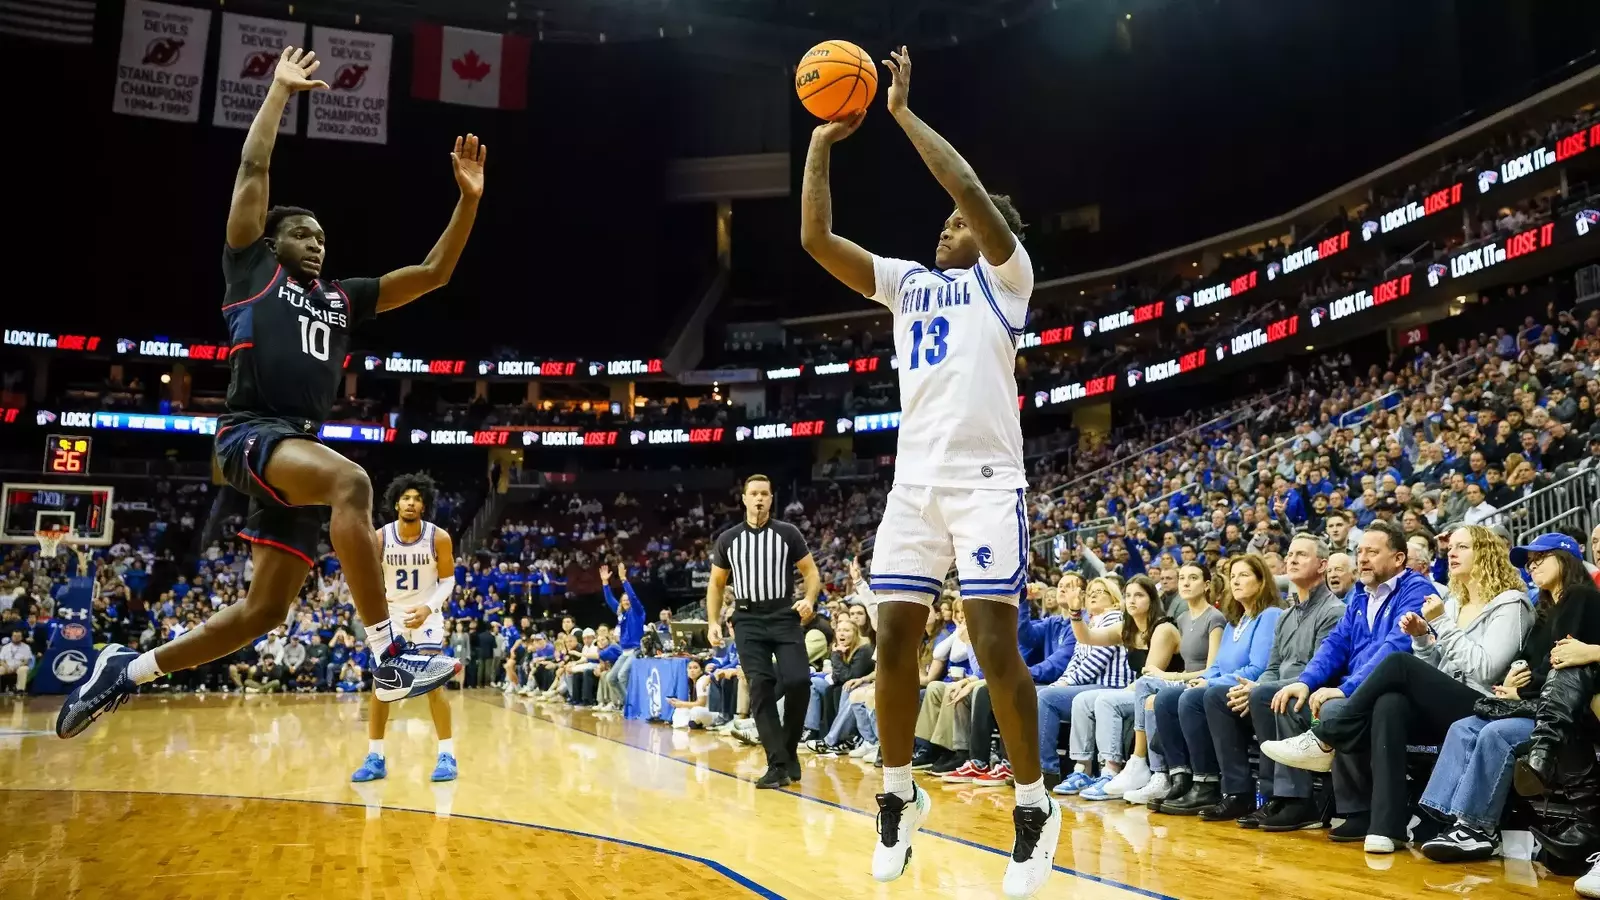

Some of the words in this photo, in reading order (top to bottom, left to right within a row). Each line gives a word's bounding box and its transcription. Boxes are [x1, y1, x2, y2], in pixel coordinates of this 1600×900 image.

[144, 20, 189, 36] DEVILS
[241, 34, 283, 49] DEVILS
[331, 46, 372, 61] DEVILS
[119, 66, 173, 85] STANLEY
[174, 74, 199, 88] CUP
[120, 81, 193, 103] CHAMPIONS
[312, 92, 361, 109] STANLEY
[362, 98, 384, 110] CUP
[315, 108, 381, 125] CHAMPIONS
[317, 122, 378, 137] 2002-2003
[1501, 153, 1534, 184] LOCK
[1533, 147, 1546, 170] IT
[1556, 130, 1586, 162] LOSE
[1380, 206, 1407, 233] LOCK
[1406, 202, 1417, 222] IT
[1425, 188, 1449, 216] LOSE
[1451, 183, 1463, 204] IT
[1282, 250, 1304, 274] LOCK
[1304, 246, 1313, 265] IT
[1319, 235, 1339, 259] LOSE
[1341, 230, 1350, 250] IT
[1451, 248, 1483, 278] LOCK
[1483, 243, 1496, 267] IT
[1506, 229, 1537, 260] LOSE
[1541, 223, 1554, 247] IT
[1194, 286, 1217, 307] LOCK
[1217, 283, 1225, 300] IT
[1231, 274, 1248, 296] LOSE
[1249, 270, 1257, 287] IT
[1330, 294, 1355, 320] LOCK
[1355, 290, 1366, 311] IT
[1374, 279, 1398, 305] LOSE
[1400, 274, 1411, 295] IT
[1099, 313, 1120, 332] LOCK
[1120, 311, 1128, 327] IT
[1134, 304, 1154, 323] LOSE
[1154, 301, 1164, 318] IT
[4, 330, 36, 346] LOCK
[37, 333, 49, 347] IT
[58, 335, 86, 350] LOSE
[87, 337, 100, 350] IT
[298, 315, 330, 361] 10
[910, 316, 950, 370] 13
[1026, 333, 1035, 347] IT
[1042, 328, 1062, 345] LOSE
[1064, 326, 1074, 340] IT
[1231, 332, 1253, 355] LOCK
[1252, 328, 1261, 348] IT
[1268, 319, 1288, 342] LOSE
[1289, 316, 1298, 334] IT
[1407, 329, 1421, 344] 20
[140, 340, 169, 356] LOCK
[170, 343, 182, 357] IT
[190, 345, 216, 359] LOSE
[217, 347, 230, 360] IT
[386, 358, 411, 372] LOCK
[412, 359, 423, 372] IT
[429, 360, 454, 373] LOSE
[454, 361, 466, 373] IT
[498, 361, 523, 375] LOCK
[524, 362, 534, 375] IT
[541, 362, 564, 376] LOSE
[566, 363, 576, 375] IT
[608, 360, 631, 374] LOCK
[632, 360, 642, 374] IT
[869, 357, 878, 370] IT
[1145, 362, 1168, 383] LOCK
[1168, 359, 1176, 377] IT
[1180, 352, 1197, 372] LOSE
[1198, 348, 1206, 366] IT
[1050, 385, 1071, 404] LOCK
[1072, 383, 1080, 399] IT
[1086, 377, 1106, 395] LOSE
[1107, 375, 1116, 391] IT
[61, 412, 91, 427] LOCK
[754, 424, 776, 439] LOCK
[777, 423, 786, 437] IT
[792, 421, 814, 436] LOSE
[814, 420, 824, 434] IT
[385, 429, 397, 441] IT
[431, 430, 456, 444] LOCK
[457, 430, 468, 444] IT
[474, 431, 497, 445] LOSE
[498, 431, 509, 444] IT
[542, 432, 567, 445] LOCK
[568, 432, 578, 445] IT
[584, 432, 606, 444] LOSE
[607, 432, 618, 444] IT
[649, 430, 672, 444] LOCK
[673, 429, 683, 443] IT
[690, 428, 712, 442] LOSE
[713, 428, 724, 441] IT
[54, 450, 80, 470] 26
[386, 554, 407, 566] SETON
[412, 554, 430, 566] HALL
[396, 569, 418, 590] 21
